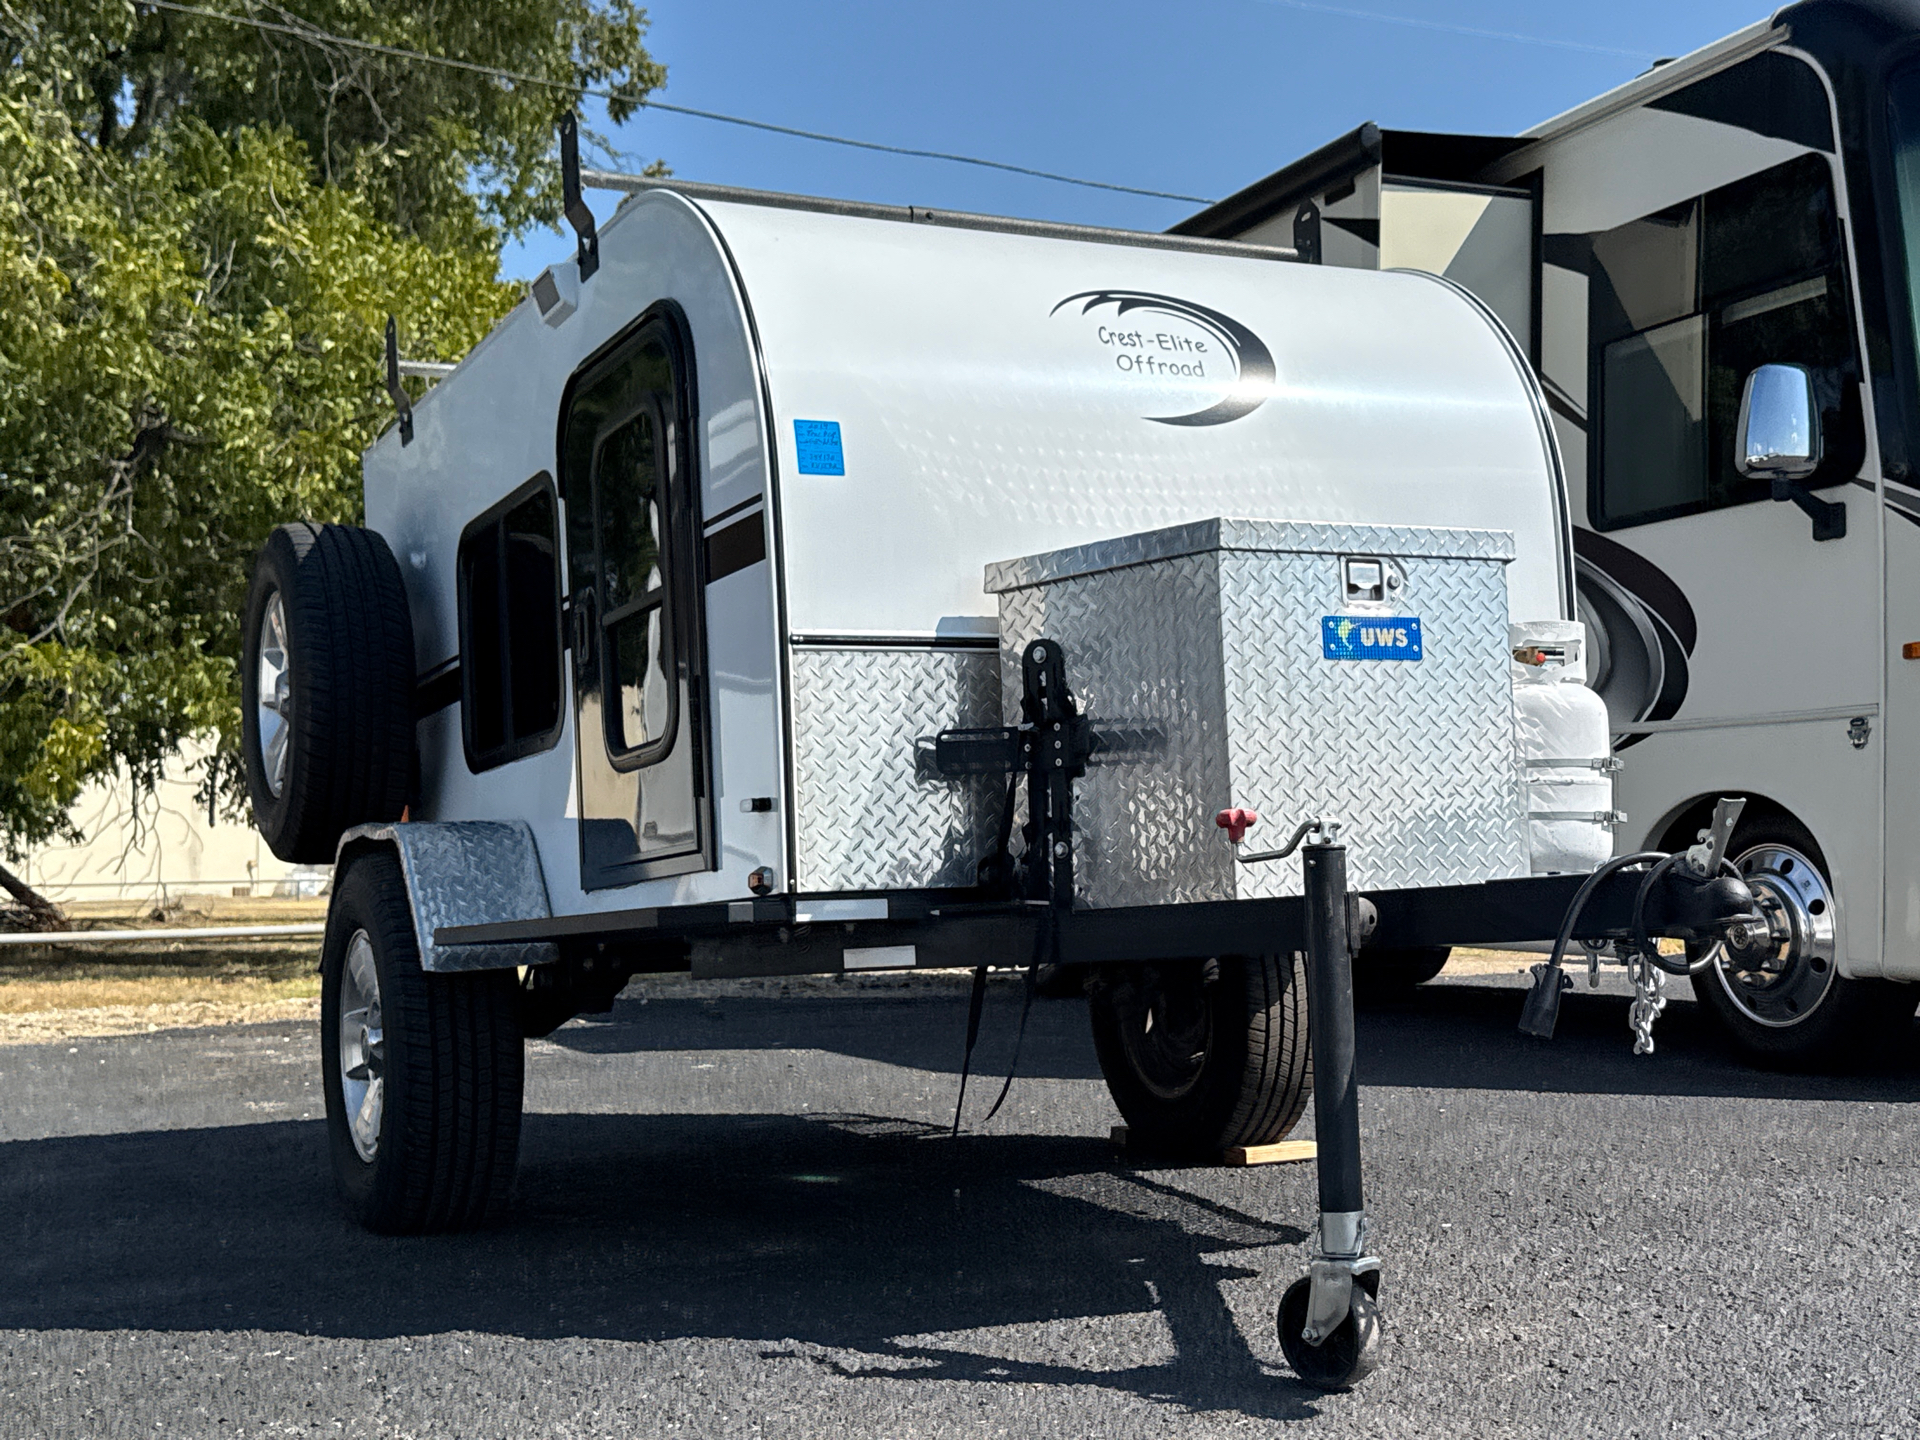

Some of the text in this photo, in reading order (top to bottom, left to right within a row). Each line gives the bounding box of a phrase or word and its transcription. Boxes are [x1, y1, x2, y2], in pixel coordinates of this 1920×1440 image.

[1098, 326, 1208, 353] Crest-Elite
[1116, 354, 1205, 377] Offroad
[1360, 627, 1408, 648] UWS
